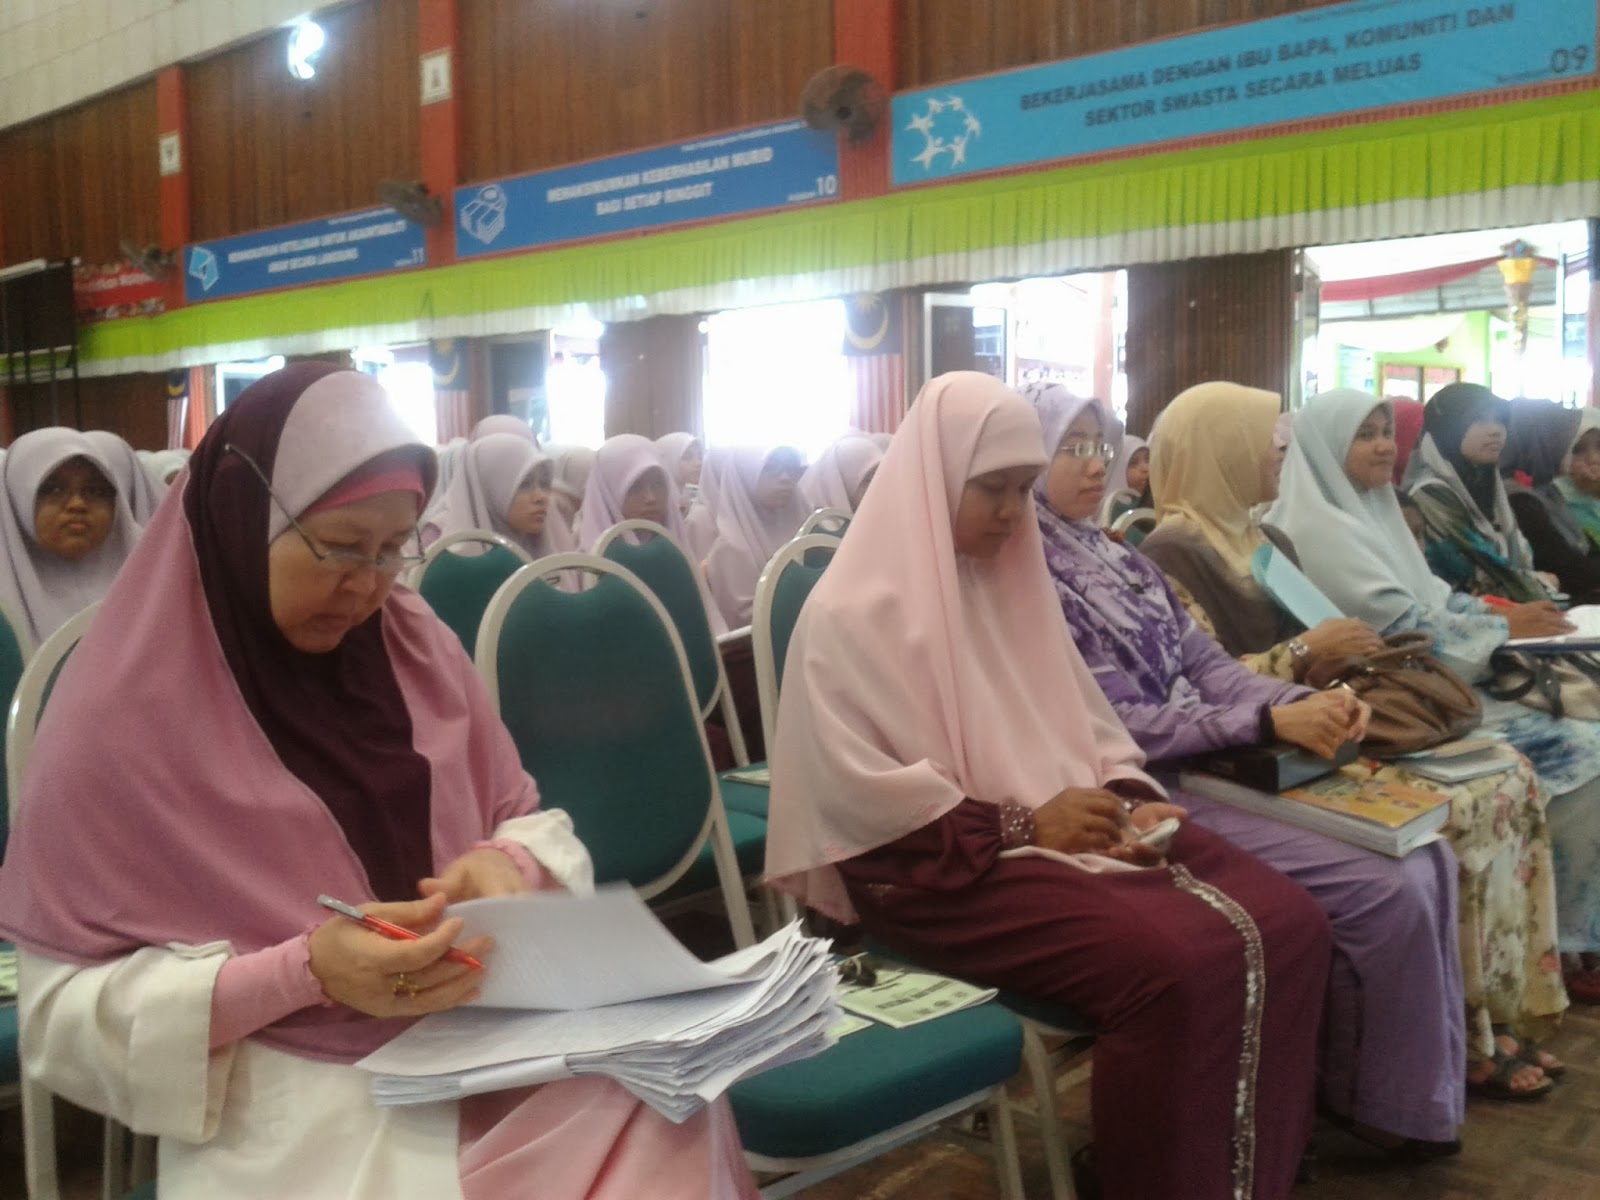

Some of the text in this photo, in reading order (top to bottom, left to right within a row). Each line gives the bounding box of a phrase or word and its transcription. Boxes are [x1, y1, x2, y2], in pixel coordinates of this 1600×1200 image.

[1020, 72, 1147, 111] BEKERJASAMA
[1152, 56, 1231, 86] DENGAN
[1237, 48, 1272, 69] IBU
[1345, 13, 1457, 49] KOMUNITI
[1467, 3, 1515, 28] DAN
[1551, 45, 1589, 74] 09
[1085, 52, 1422, 127] SEKTOR SWASTA SECARA MELUAS
[815, 174, 838, 197] 10
